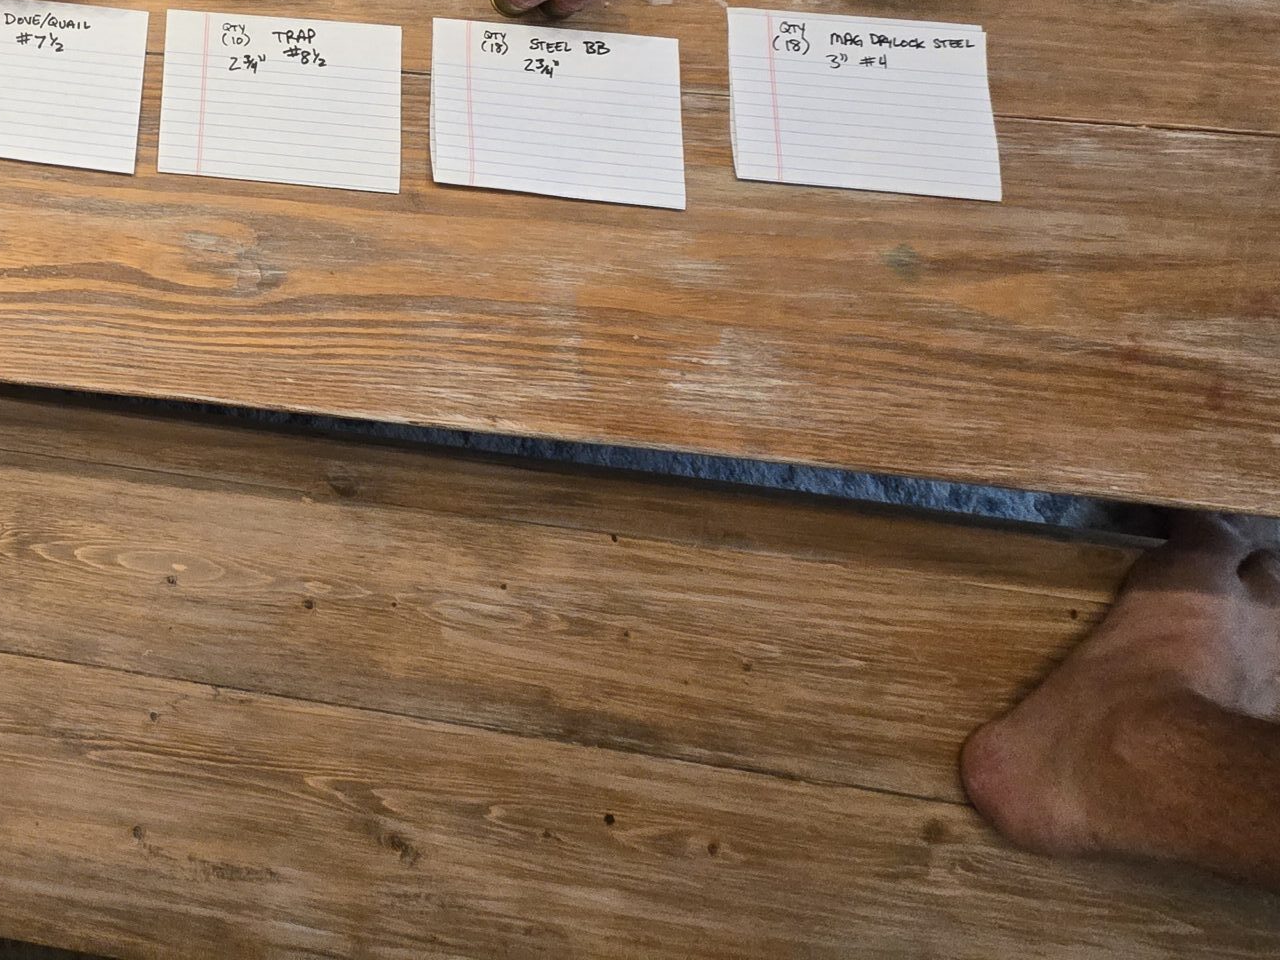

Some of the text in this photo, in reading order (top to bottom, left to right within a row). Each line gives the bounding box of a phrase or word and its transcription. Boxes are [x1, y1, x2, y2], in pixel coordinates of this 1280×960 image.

[4, 12, 92, 30] DOVE/QUAIL
[222, 22, 245, 34] QTY
[779, 21, 806, 36] QTY
[221, 33, 251, 46] (10)
[272, 28, 316, 44] TRAP
[483, 30, 507, 41] QTY
[830, 33, 976, 49] MAG DRYLOCK STEEL
[481, 40, 508, 55] (18)
[529, 38, 611, 55] STEEL BB
[772, 35, 810, 55] (18)
[859, 54, 888, 69] #4
